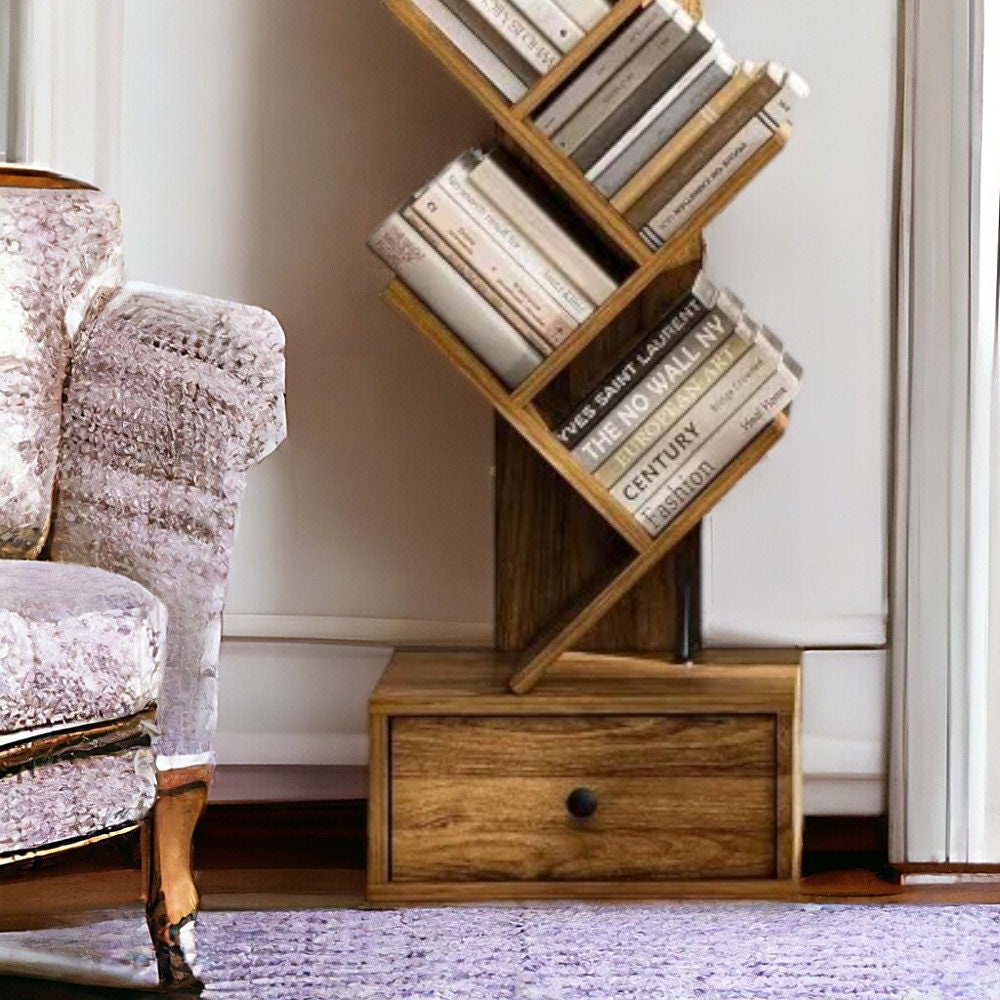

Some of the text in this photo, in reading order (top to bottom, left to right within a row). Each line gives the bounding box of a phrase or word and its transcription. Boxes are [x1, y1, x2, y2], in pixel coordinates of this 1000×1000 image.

[556, 297, 702, 443] YVES SAINT LAURENT
[581, 313, 725, 462] THE NO WALL NY
[614, 380, 702, 468] EUROPEAN
[620, 421, 701, 502] CENTURY
[640, 455, 717, 530] Fashion
